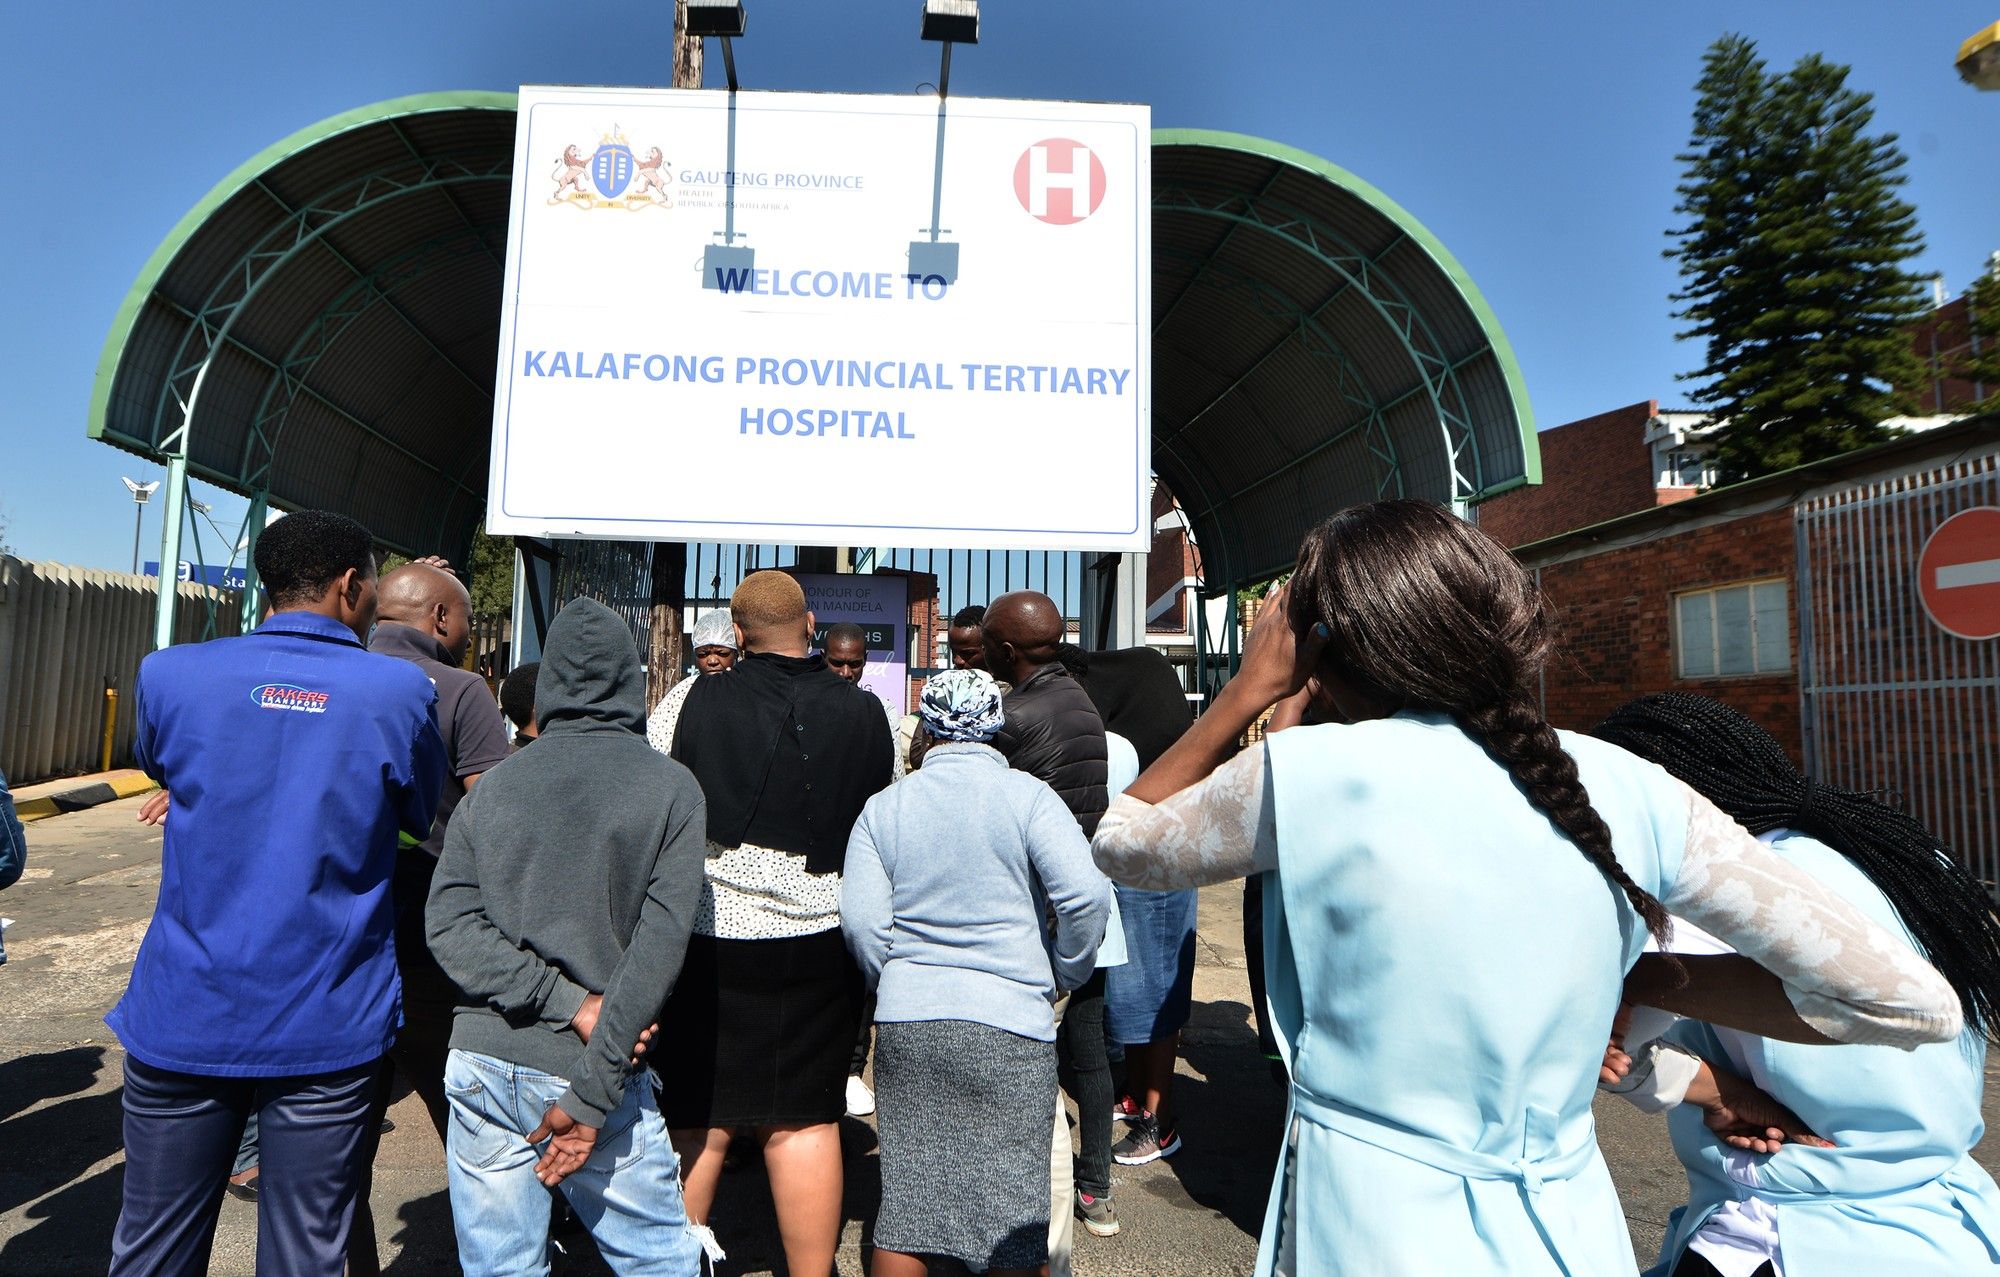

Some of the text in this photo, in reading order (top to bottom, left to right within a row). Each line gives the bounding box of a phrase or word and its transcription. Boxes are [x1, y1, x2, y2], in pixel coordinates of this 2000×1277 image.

[679, 170, 864, 189] GAUTENG PROVINCE
[1029, 145, 1090, 218] H
[678, 200, 715, 208] REPUBLIC
[715, 267, 948, 301] WELCOME TO
[523, 350, 1131, 395] KALAFONG PROVINCIAL TERTIARY
[739, 407, 916, 440] HOSPITAL
[805, 587, 871, 598] ONOUR OF
[823, 601, 883, 612] MANDELA
[261, 696, 324, 708] TRANSPORT
[262, 687, 329, 702] BAKERS
